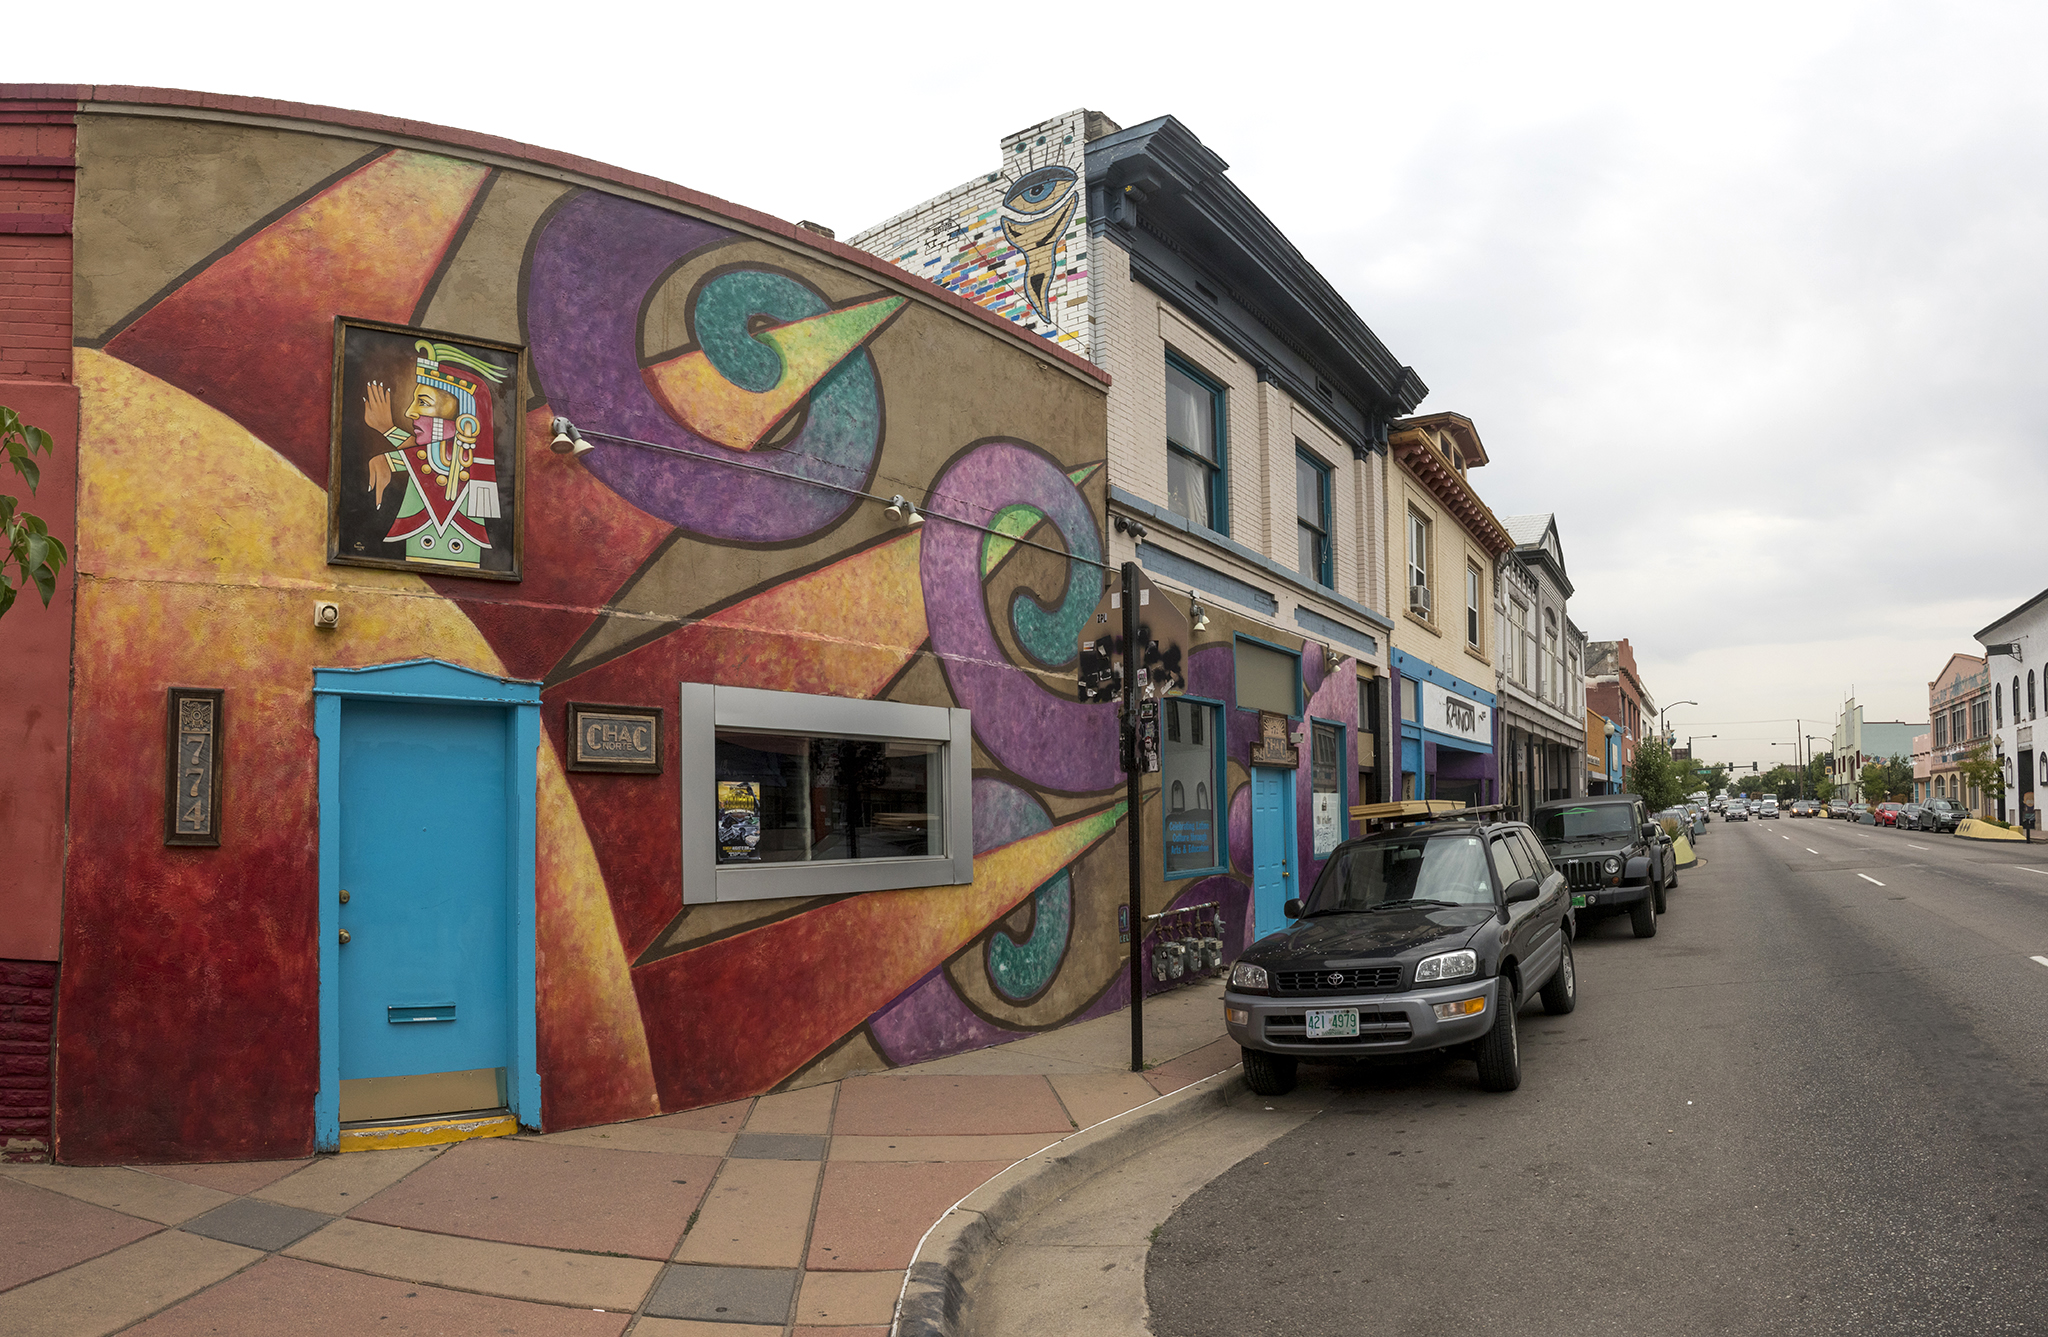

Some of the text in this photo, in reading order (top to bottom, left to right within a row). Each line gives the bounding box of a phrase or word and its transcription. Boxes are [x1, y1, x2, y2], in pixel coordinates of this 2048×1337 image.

[586, 724, 648, 752] CHAC
[602, 742, 633, 751] NORTE
[1265, 738, 1286, 758] CHAC
[182, 735, 206, 830] 774
[1171, 845, 1181, 854] Arts
[1308, 1013, 1356, 1029] 421 4979
